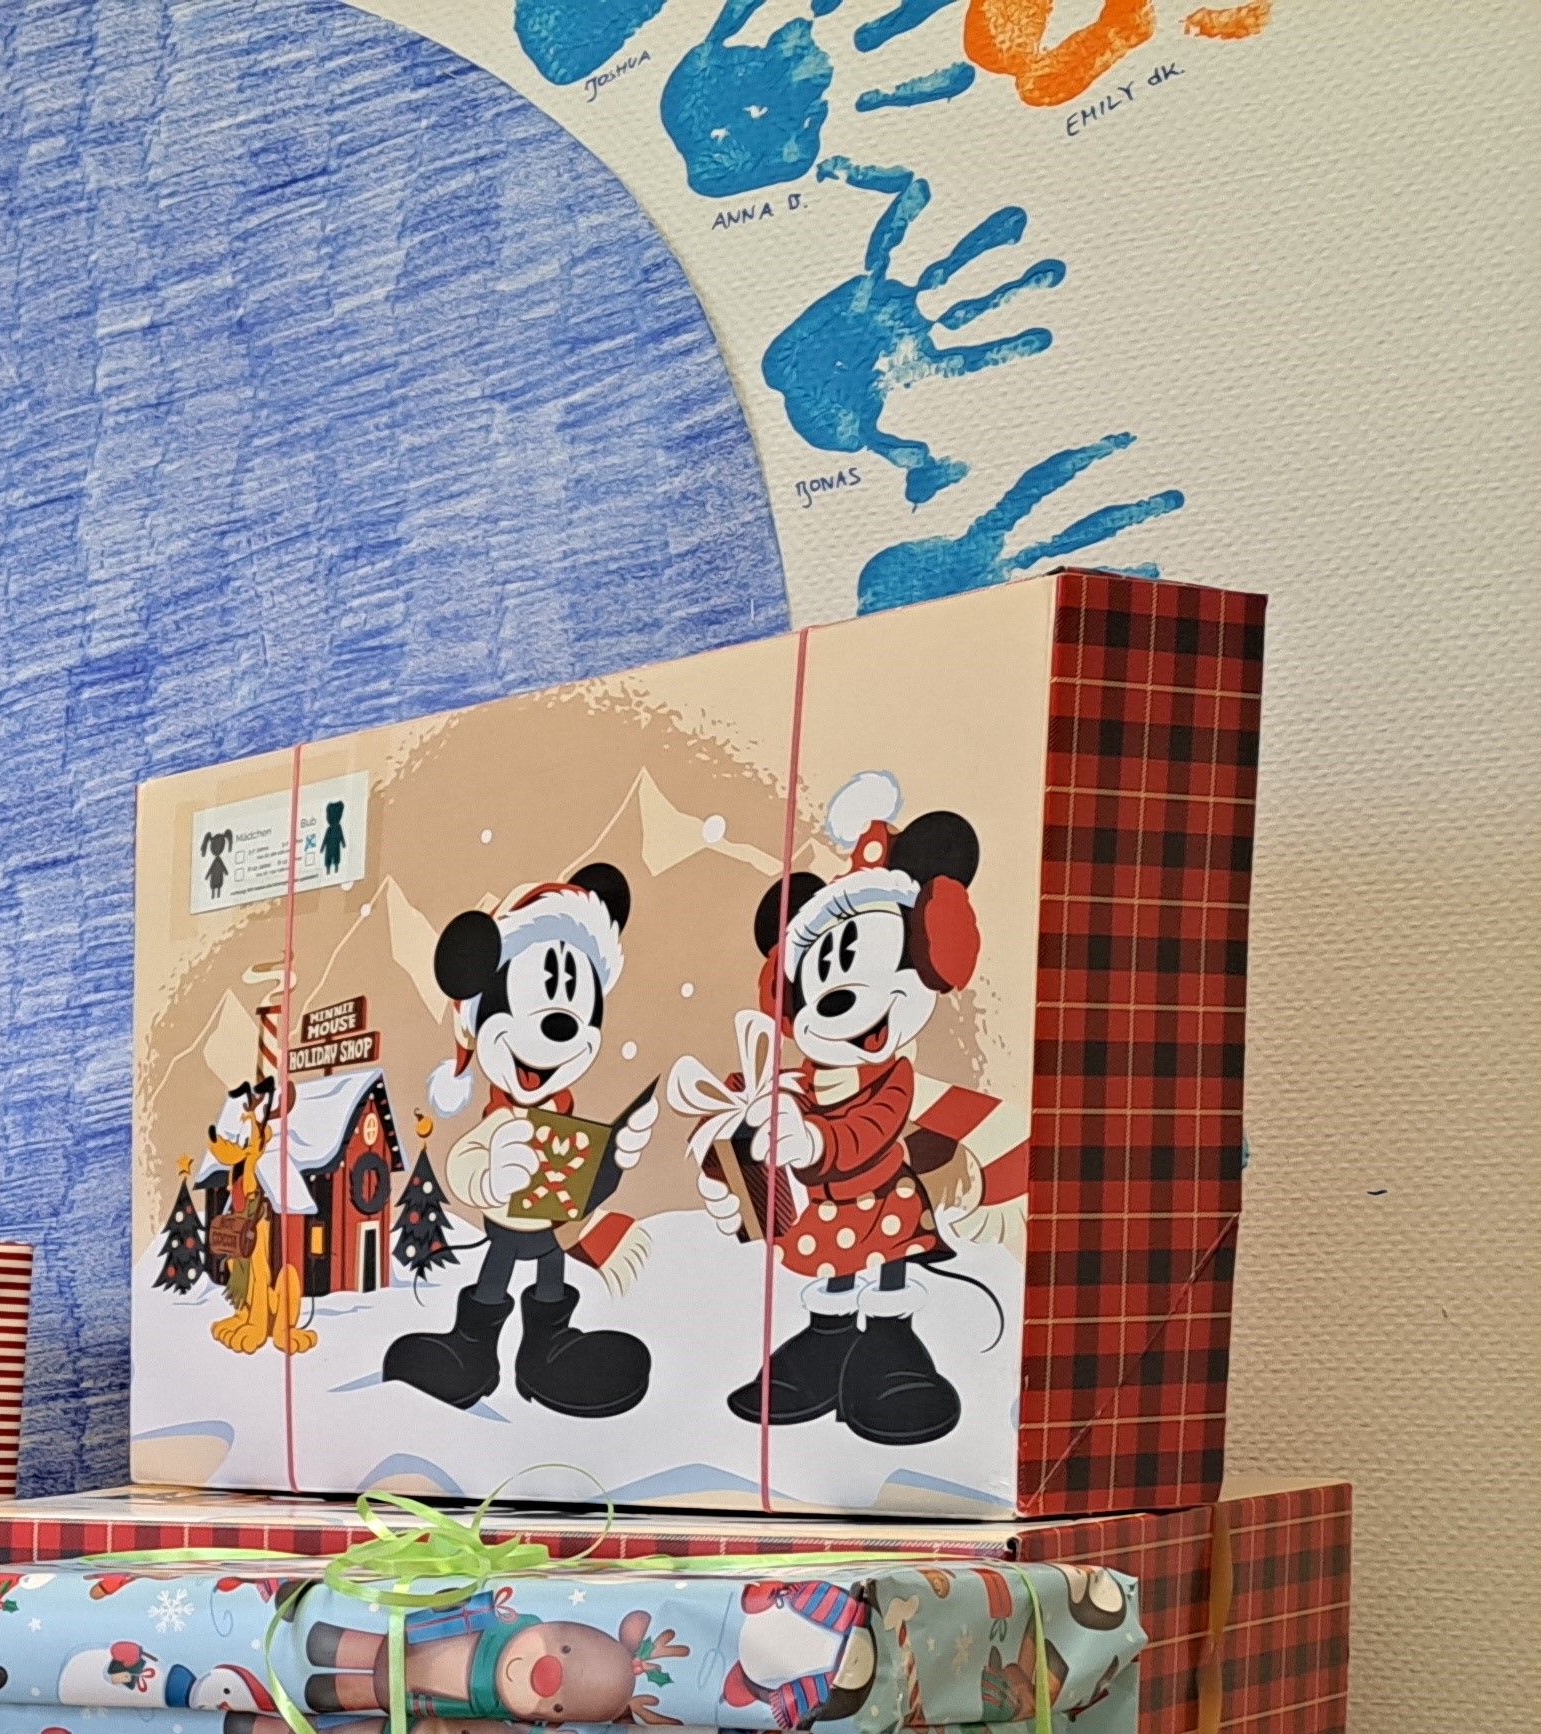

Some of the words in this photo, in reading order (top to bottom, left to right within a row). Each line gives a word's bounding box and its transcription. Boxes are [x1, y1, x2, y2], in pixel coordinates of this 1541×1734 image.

[1065, 85, 1140, 136] EMILY
[712, 202, 774, 231] ANNA
[300, 817, 317, 829] Bub
[309, 1001, 356, 1023] MINNIE
[307, 1013, 357, 1040] MOUSE
[290, 1044, 338, 1073] HOLIDAY
[339, 1037, 373, 1063] SHOP
